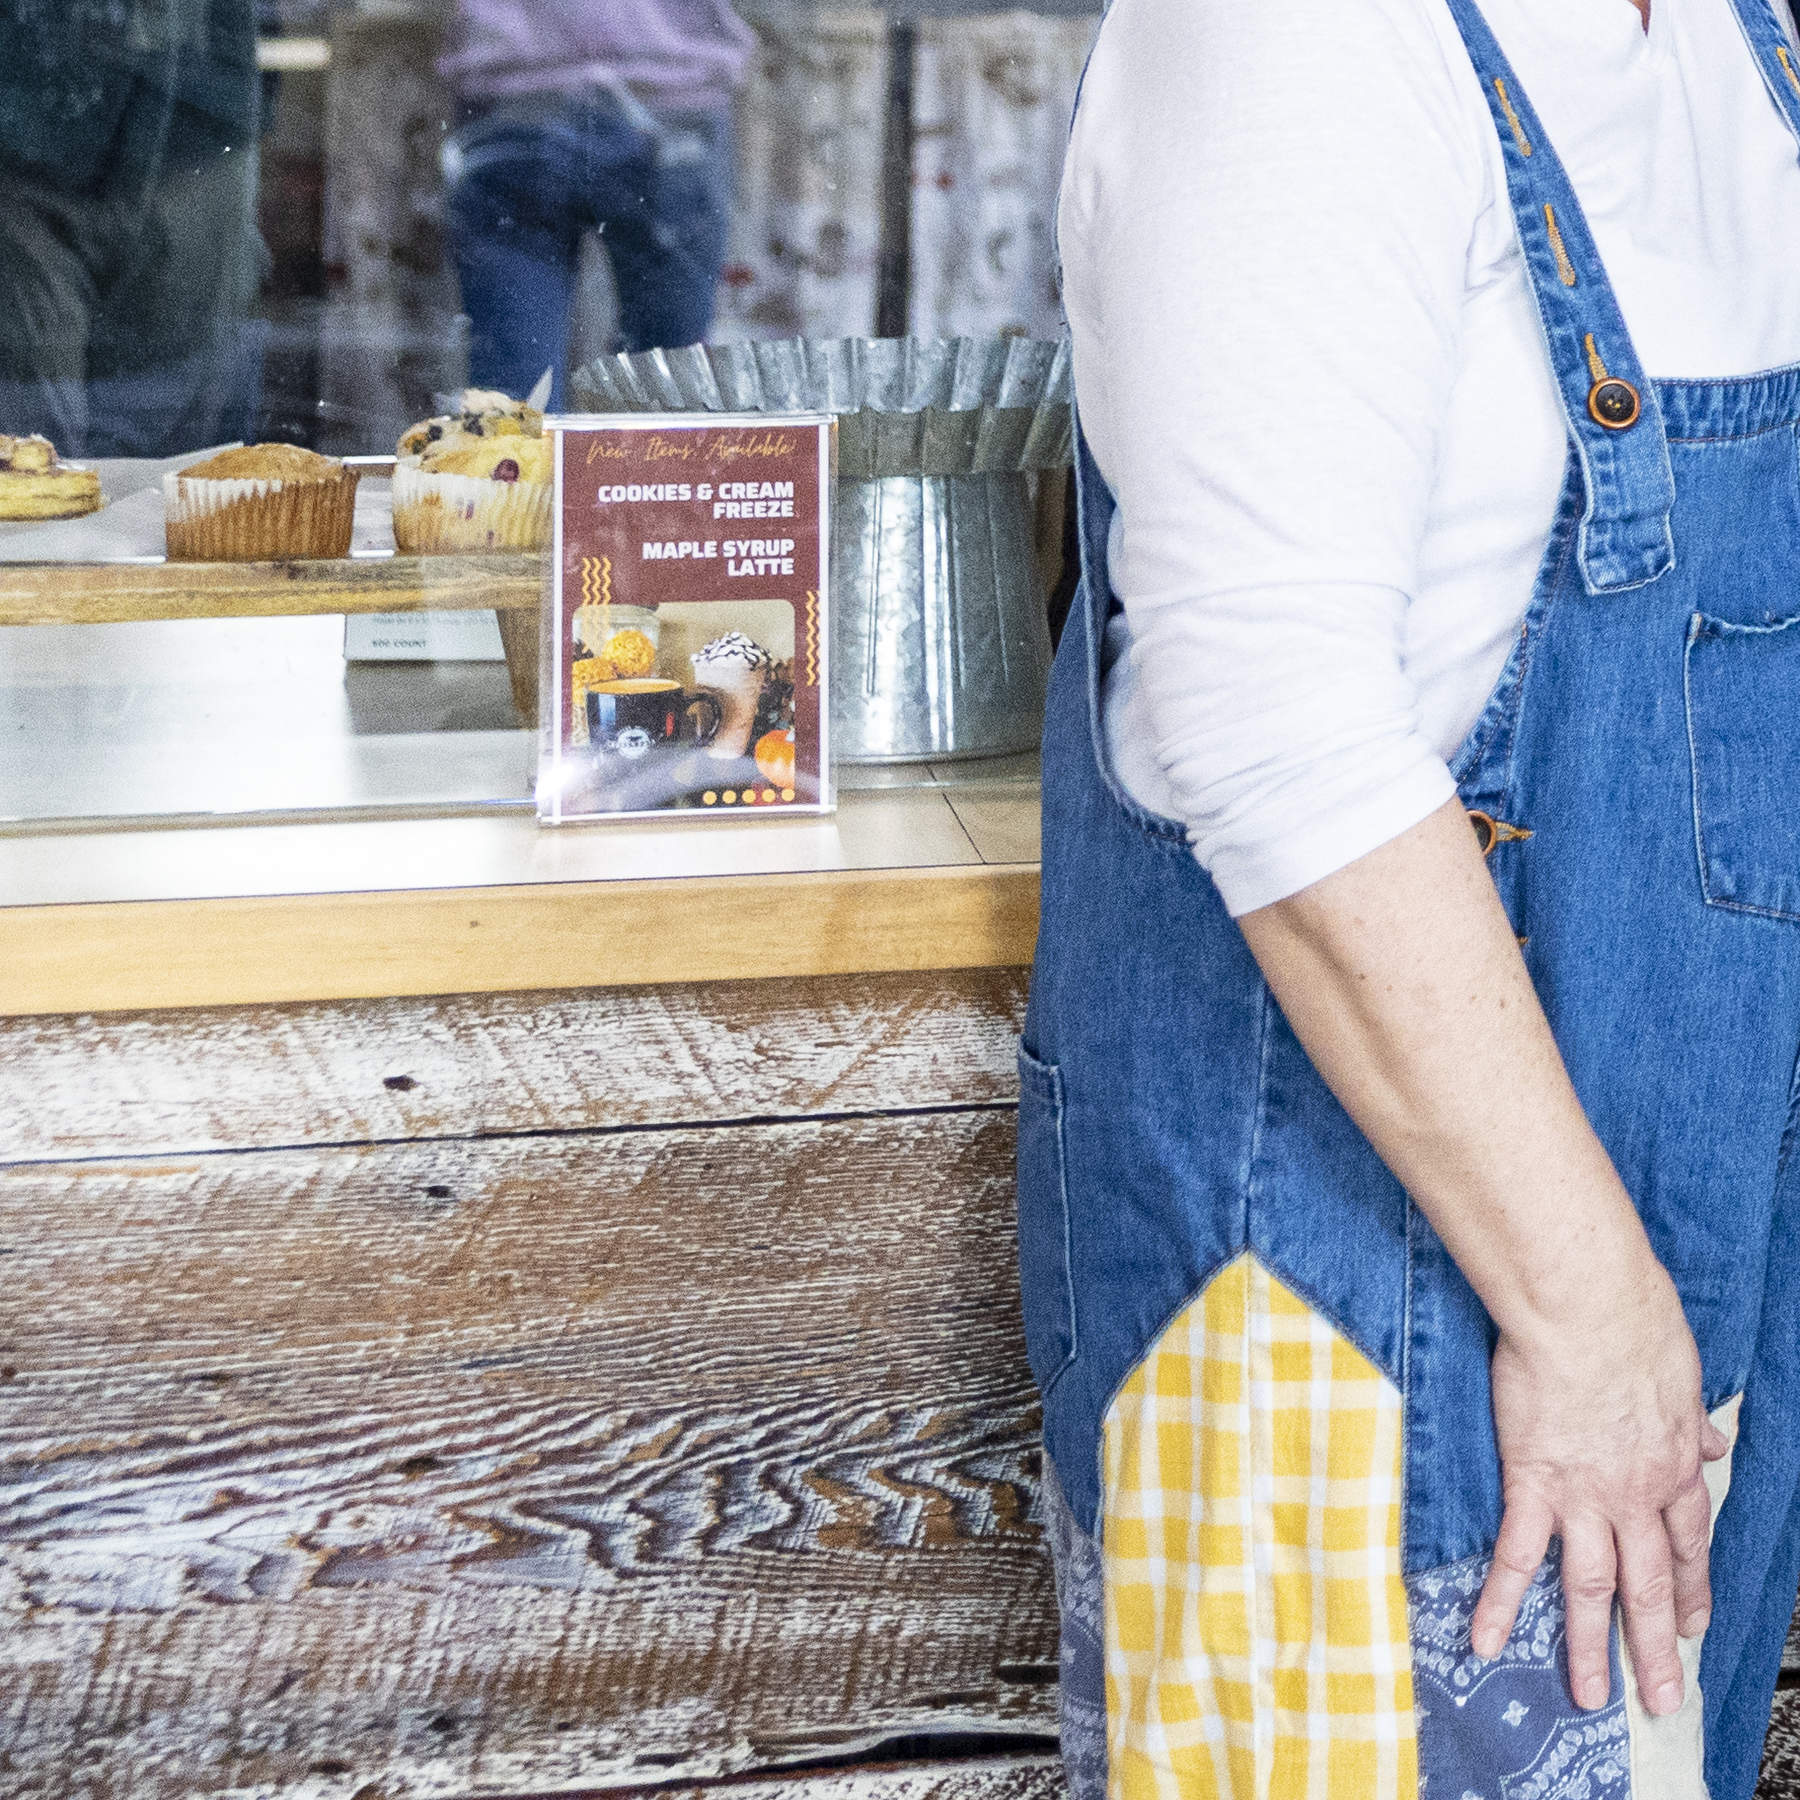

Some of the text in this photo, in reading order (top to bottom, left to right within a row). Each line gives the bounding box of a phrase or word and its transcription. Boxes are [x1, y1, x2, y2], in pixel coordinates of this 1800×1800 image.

[598, 481, 794, 503] COOKIES & CREAM
[713, 500, 794, 520] FREEZE
[642, 538, 795, 560] MAPLE SYRUP
[727, 558, 795, 577] LATTE
